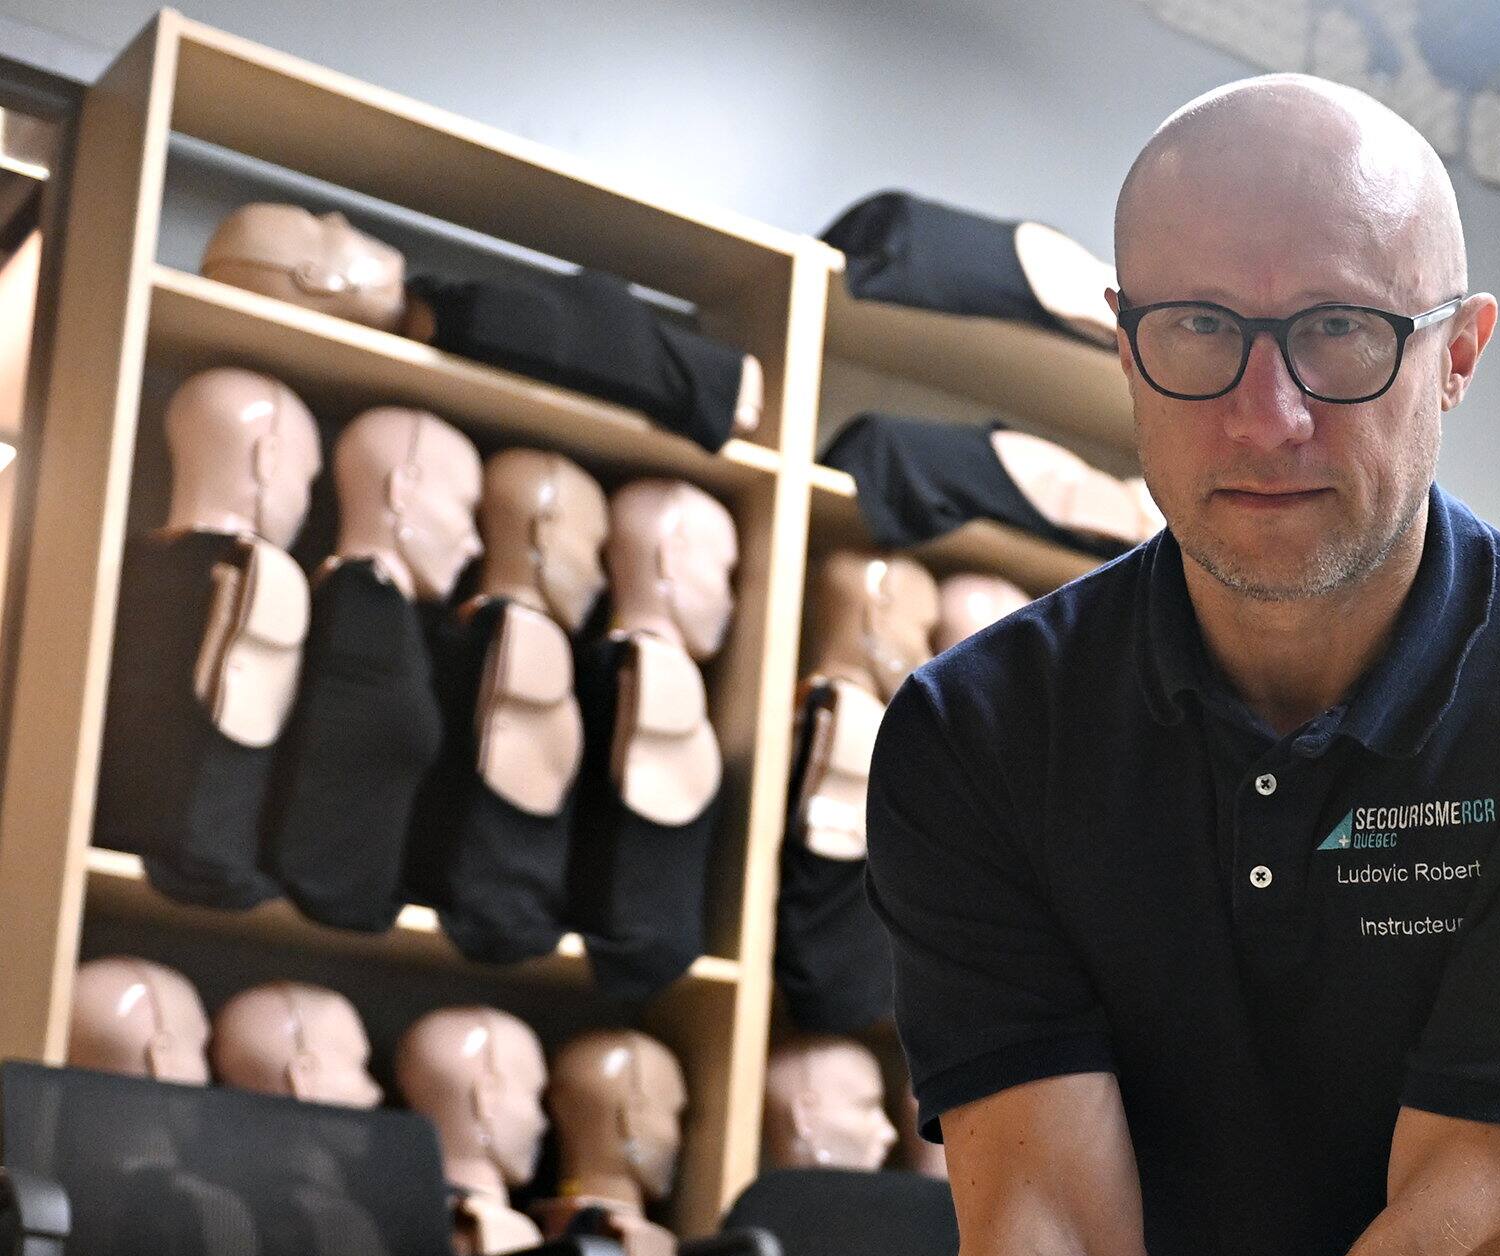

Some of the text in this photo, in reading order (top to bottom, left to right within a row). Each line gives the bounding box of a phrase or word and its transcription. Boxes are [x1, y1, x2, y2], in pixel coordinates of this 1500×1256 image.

[1355, 798, 1496, 830] SECOURISMERCR
[1353, 831, 1398, 849] QUÉBEC
[1337, 860, 1482, 884] Ludovic Robert
[1360, 916, 1464, 936] Instructeur
